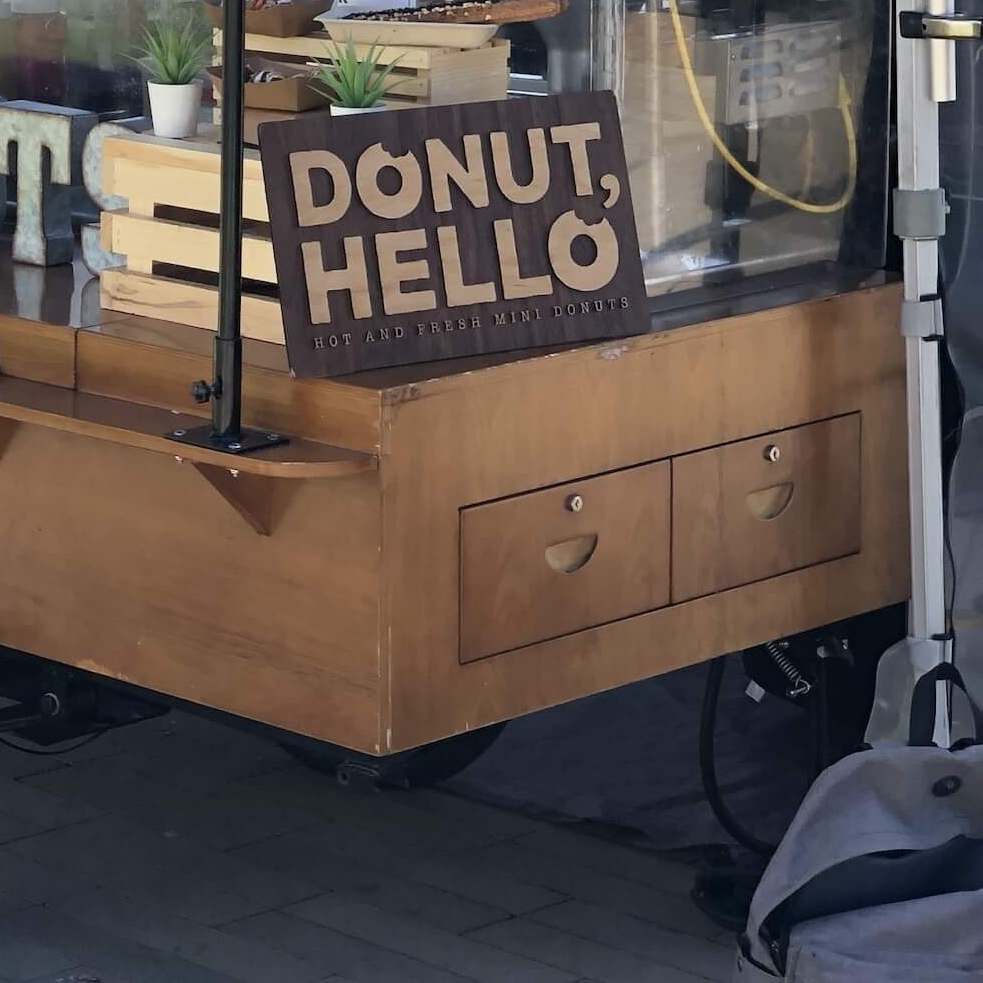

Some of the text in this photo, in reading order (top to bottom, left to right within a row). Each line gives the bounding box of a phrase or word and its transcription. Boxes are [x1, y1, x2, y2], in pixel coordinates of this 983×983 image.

[289, 122, 620, 227] DONUT,
[301, 209, 619, 325] HELLO
[313, 296, 630, 350] HOT AND FRESH MINI DONUTS
